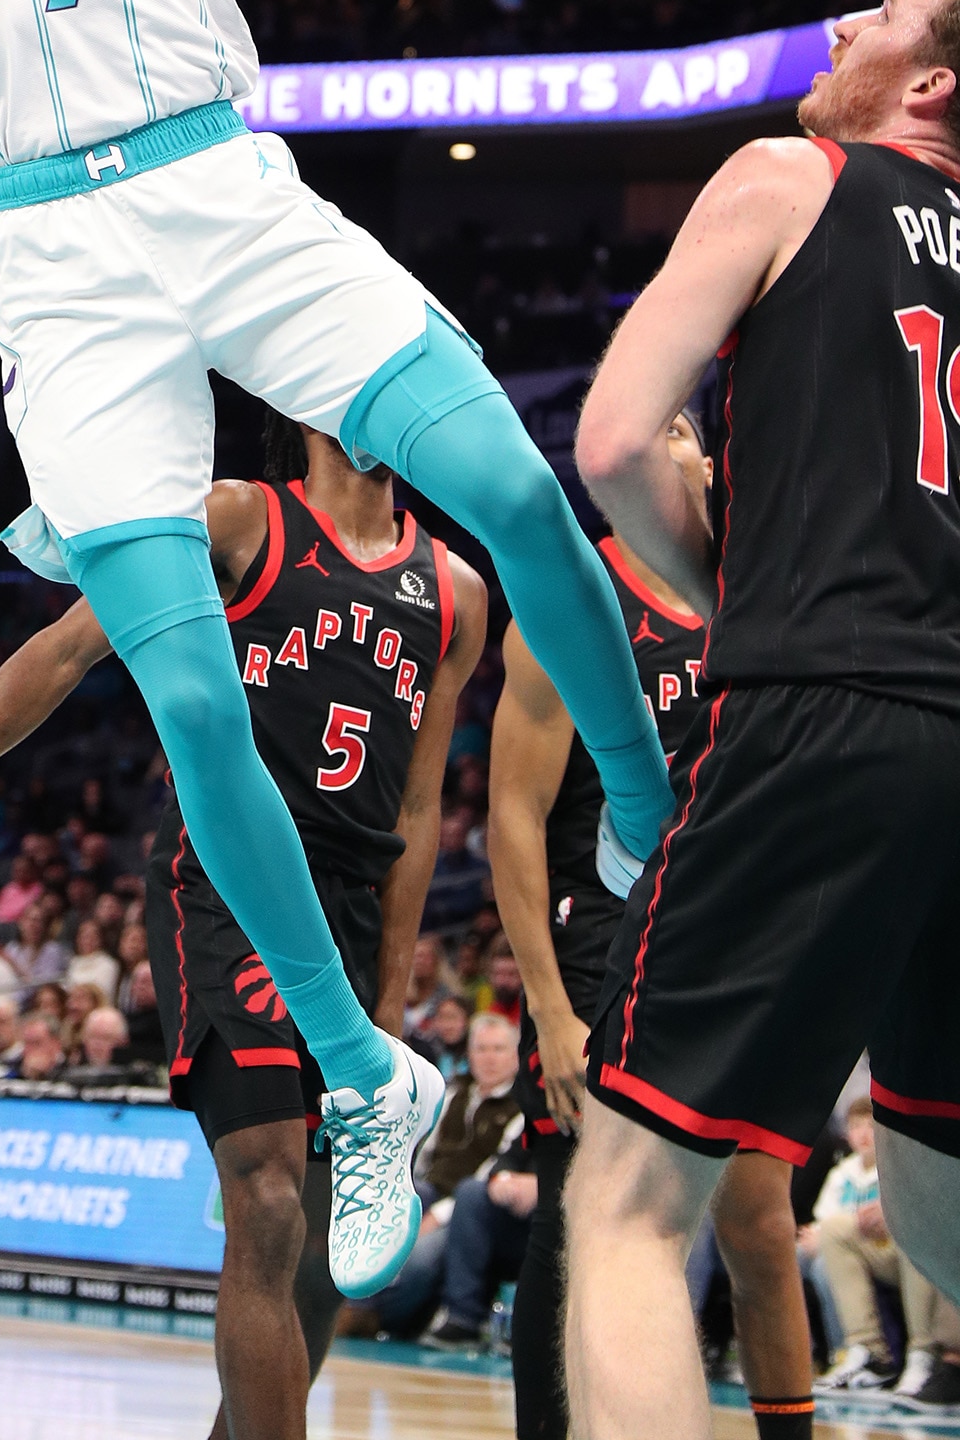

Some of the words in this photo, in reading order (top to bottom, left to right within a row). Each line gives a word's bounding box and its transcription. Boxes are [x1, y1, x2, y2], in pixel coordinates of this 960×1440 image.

[321, 68, 618, 123] HORNETS
[641, 50, 750, 110] APP
[893, 303, 960, 496] 1
[243, 601, 426, 731] RAPTORS
[316, 701, 372, 793] 5
[48, 1132, 190, 1181] PARTNER
